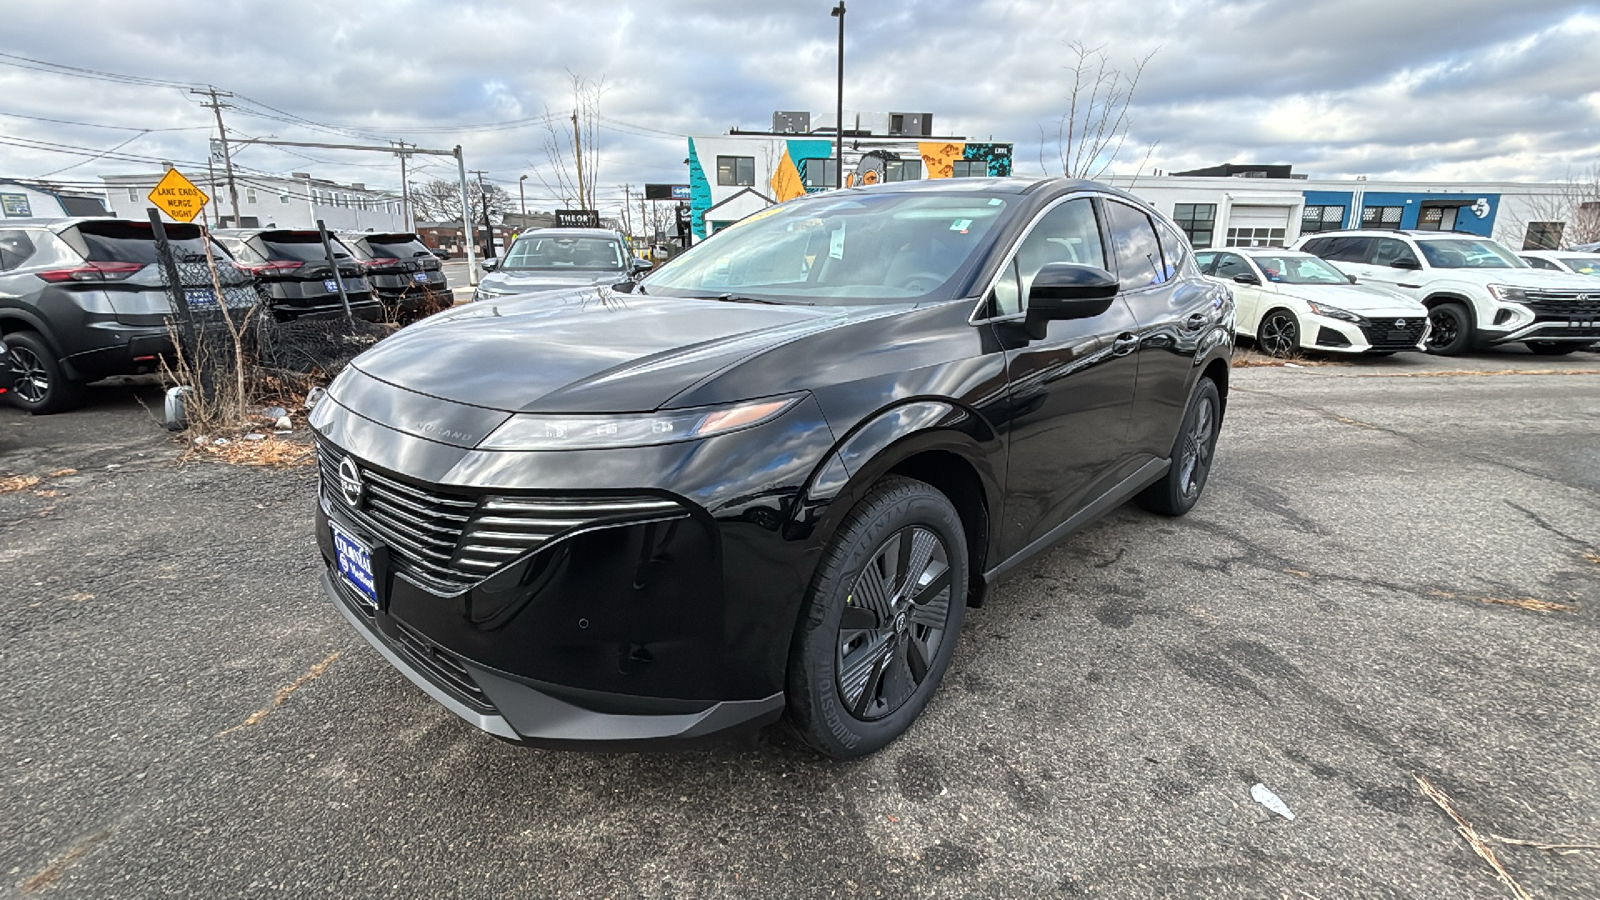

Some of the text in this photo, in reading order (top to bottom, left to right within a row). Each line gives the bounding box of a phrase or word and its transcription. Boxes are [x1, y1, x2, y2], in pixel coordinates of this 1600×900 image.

[157, 188, 198, 196] LANE ENDS
[167, 199, 193, 208] MERGE
[171, 210, 193, 218] RIGHT
[415, 421, 473, 440] MUANO
[852, 506, 904, 561] ALENZA
